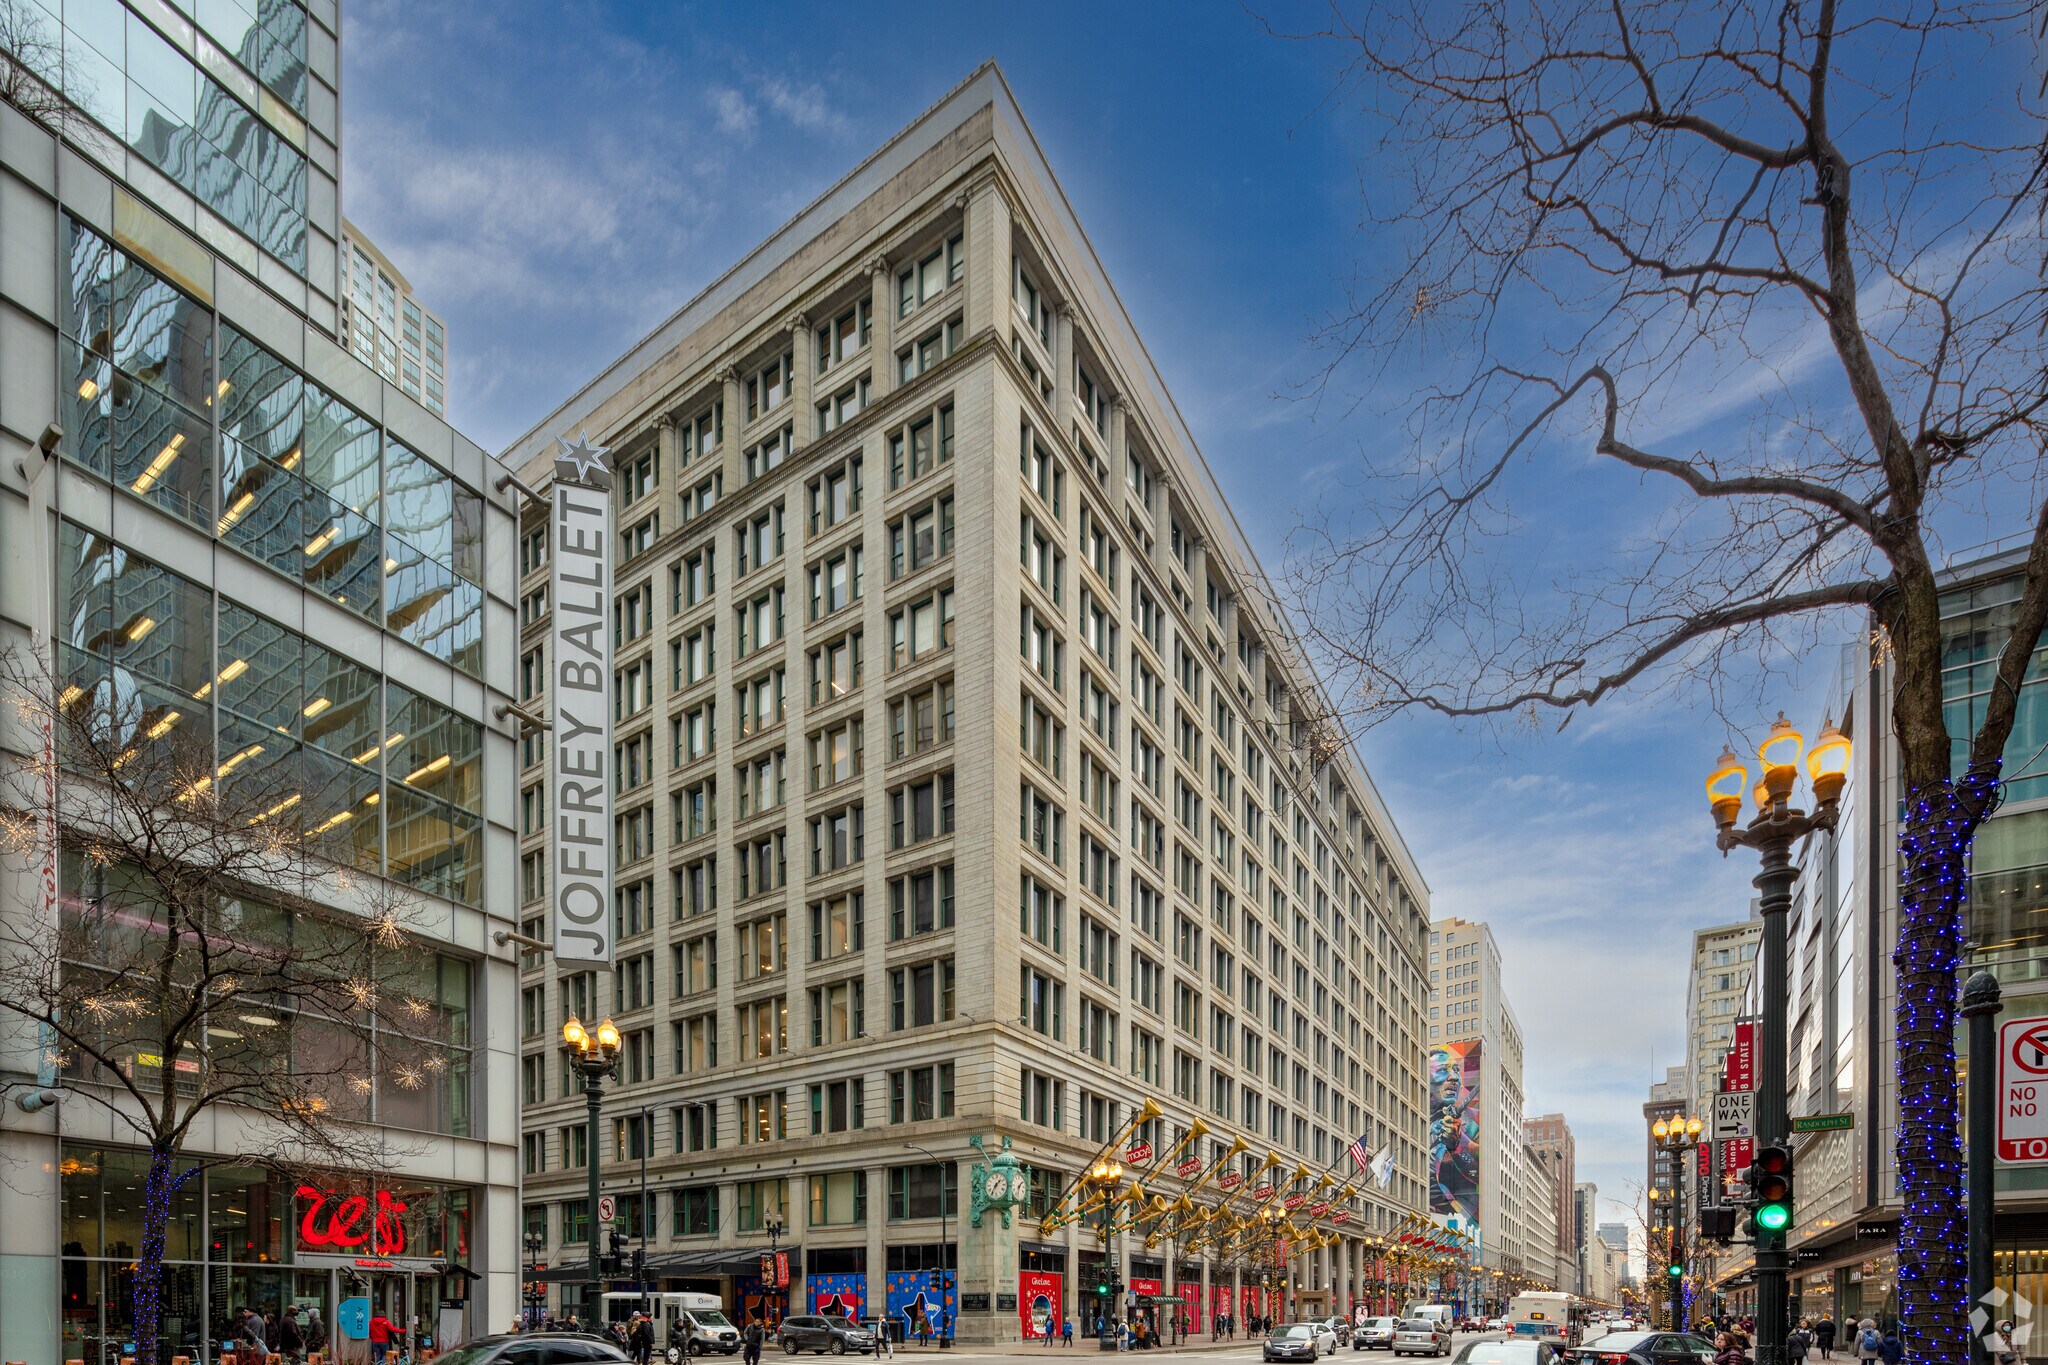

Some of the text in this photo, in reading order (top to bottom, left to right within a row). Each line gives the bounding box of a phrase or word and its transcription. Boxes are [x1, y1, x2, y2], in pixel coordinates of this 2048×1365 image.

[560, 489, 605, 956] JOFFREY BALLET
[1740, 1041, 1749, 1069] STATE
[2010, 1087, 2036, 1101] NO
[1719, 1095, 1750, 1108] ONE
[1718, 1108, 1751, 1121] WAY
[2010, 1103, 2037, 1117] NO
[1797, 1120, 1838, 1129] RANDOLPH
